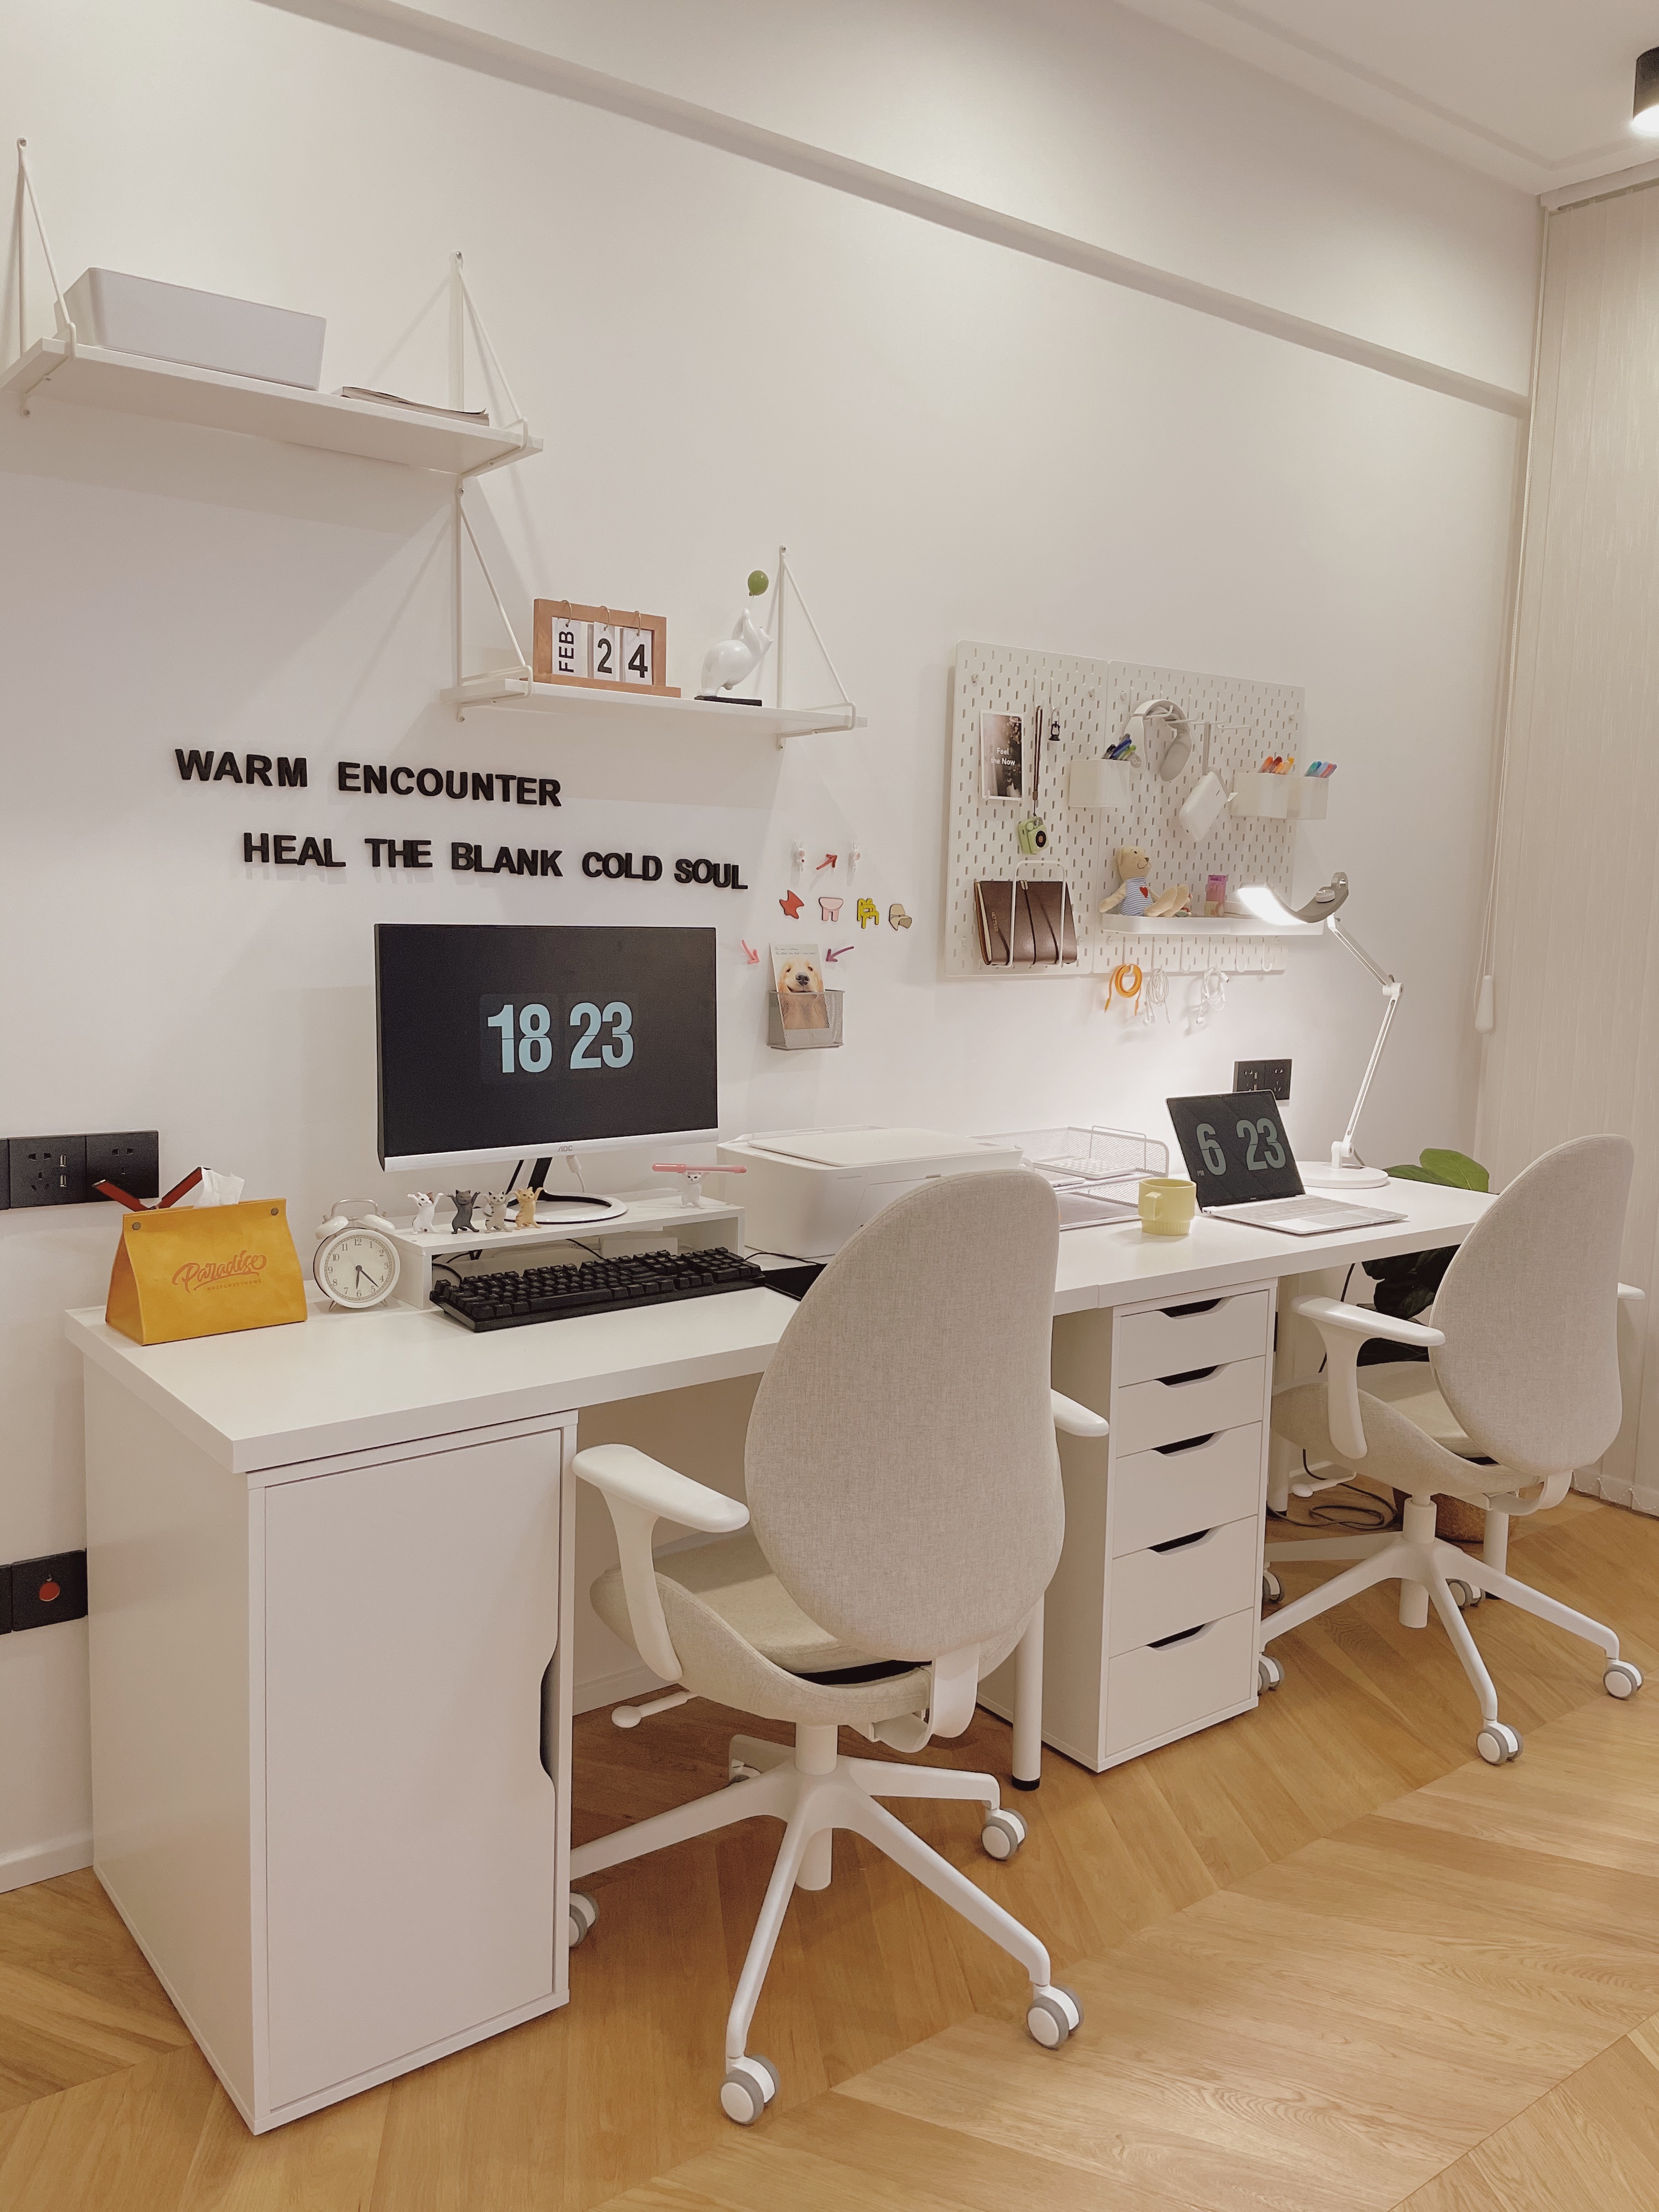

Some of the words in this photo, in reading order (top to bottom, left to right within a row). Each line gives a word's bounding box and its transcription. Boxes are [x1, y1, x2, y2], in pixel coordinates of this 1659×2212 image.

[558, 631, 574, 673] FEB
[174, 748, 308, 788] WARM
[338, 761, 562, 807] ENCOUNTER
[1001, 758, 1015, 766] Now
[244, 832, 347, 867] HEAL
[364, 838, 433, 868] THE
[451, 842, 563, 877] BLANK
[582, 851, 663, 881] COLD
[674, 859, 748, 890] SOUL
[487, 1003, 552, 1073] 18
[569, 1001, 634, 1069] 23
[1196, 1123, 1226, 1176] 6
[1236, 1118, 1286, 1171] 23
[172, 1250, 267, 1294] Paradise
[341, 1243, 348, 1251] 11
